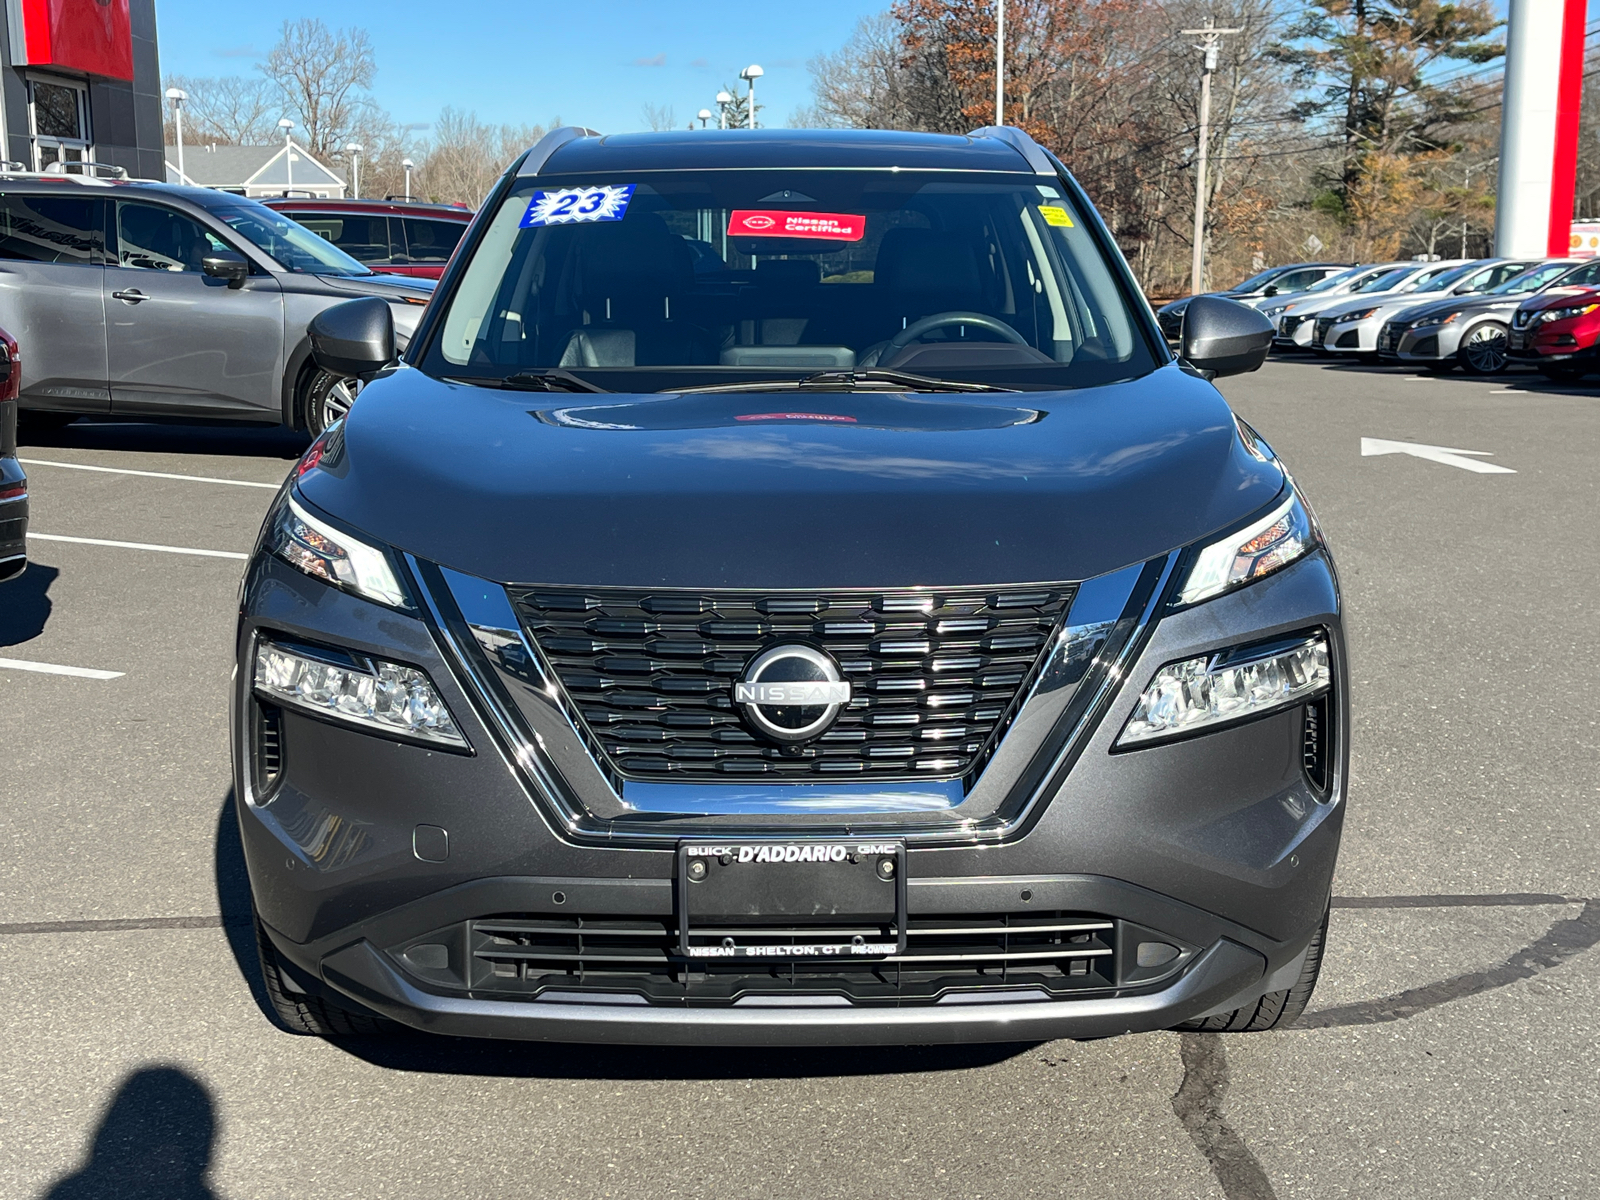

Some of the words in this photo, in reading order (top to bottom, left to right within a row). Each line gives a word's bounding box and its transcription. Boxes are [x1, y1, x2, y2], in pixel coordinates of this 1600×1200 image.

[548, 192, 606, 216] 23
[786, 217, 839, 226] Nissan
[784, 224, 852, 234] Certified
[738, 685, 846, 701] NISSAN
[688, 846, 732, 856] BUICK
[738, 845, 847, 862] D'ADDARIO
[857, 845, 896, 855] GMC
[689, 947, 735, 957] NISSAN
[745, 945, 819, 956] SHELTON,
[822, 945, 842, 955] CT
